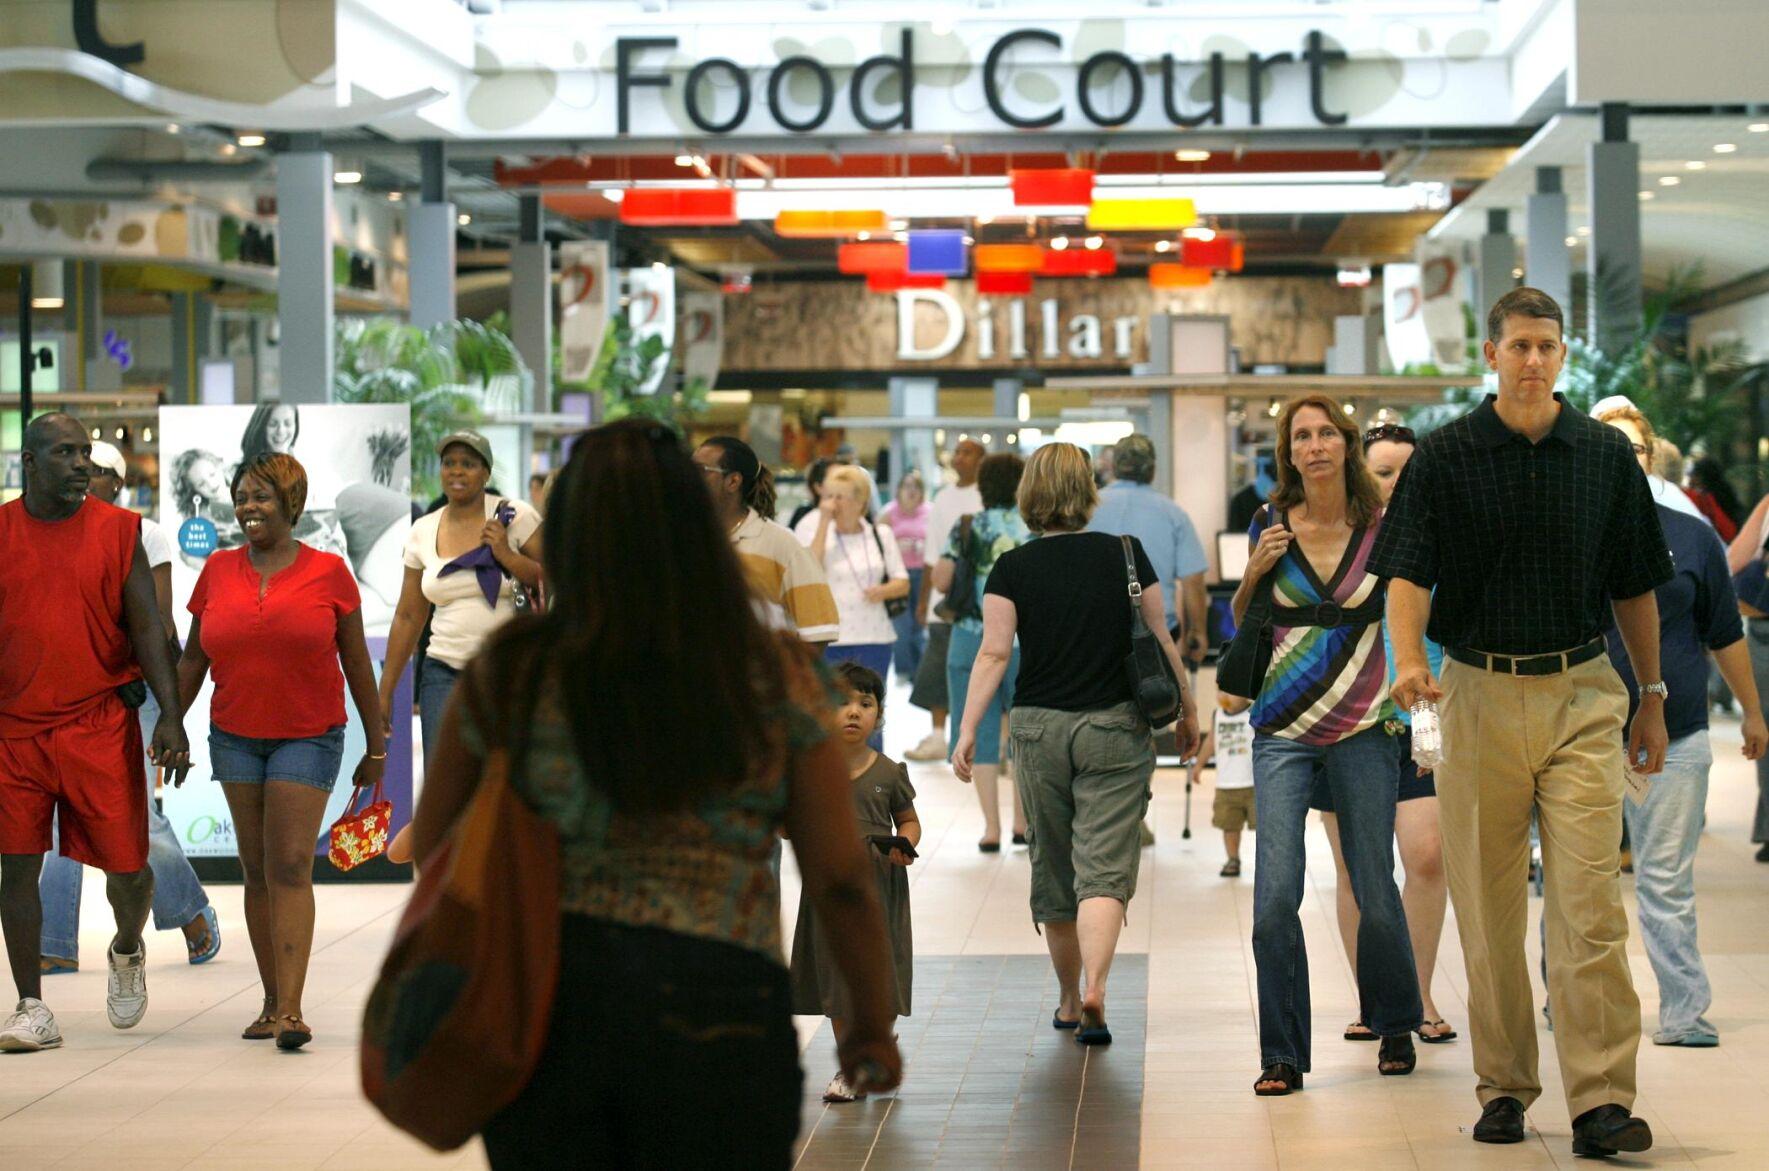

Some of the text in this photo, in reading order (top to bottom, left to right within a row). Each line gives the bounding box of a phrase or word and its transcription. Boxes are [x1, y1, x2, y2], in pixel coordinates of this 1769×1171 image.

[616, 28, 1347, 134] Food Court
[896, 289, 1152, 360] Dillar
